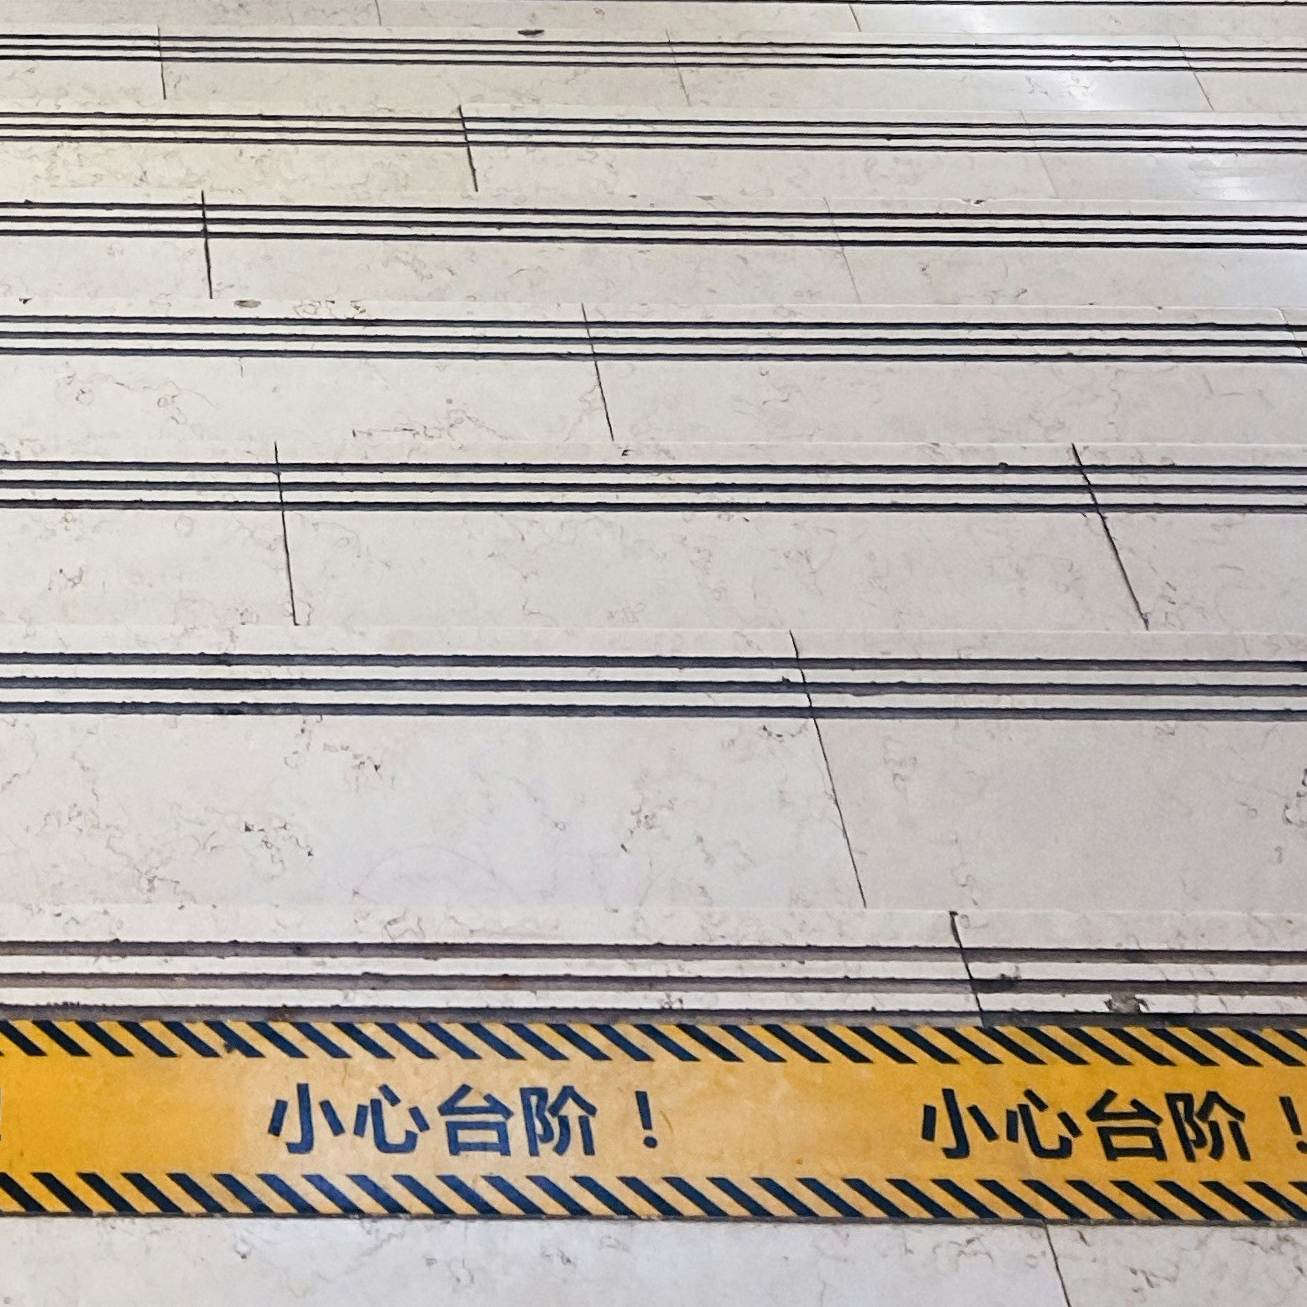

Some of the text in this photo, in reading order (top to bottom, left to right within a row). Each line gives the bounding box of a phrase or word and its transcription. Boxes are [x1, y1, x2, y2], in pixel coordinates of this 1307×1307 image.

[266, 1083, 659, 1157] 小心台阶！
[921, 1088, 1307, 1163] 小心台阶！
